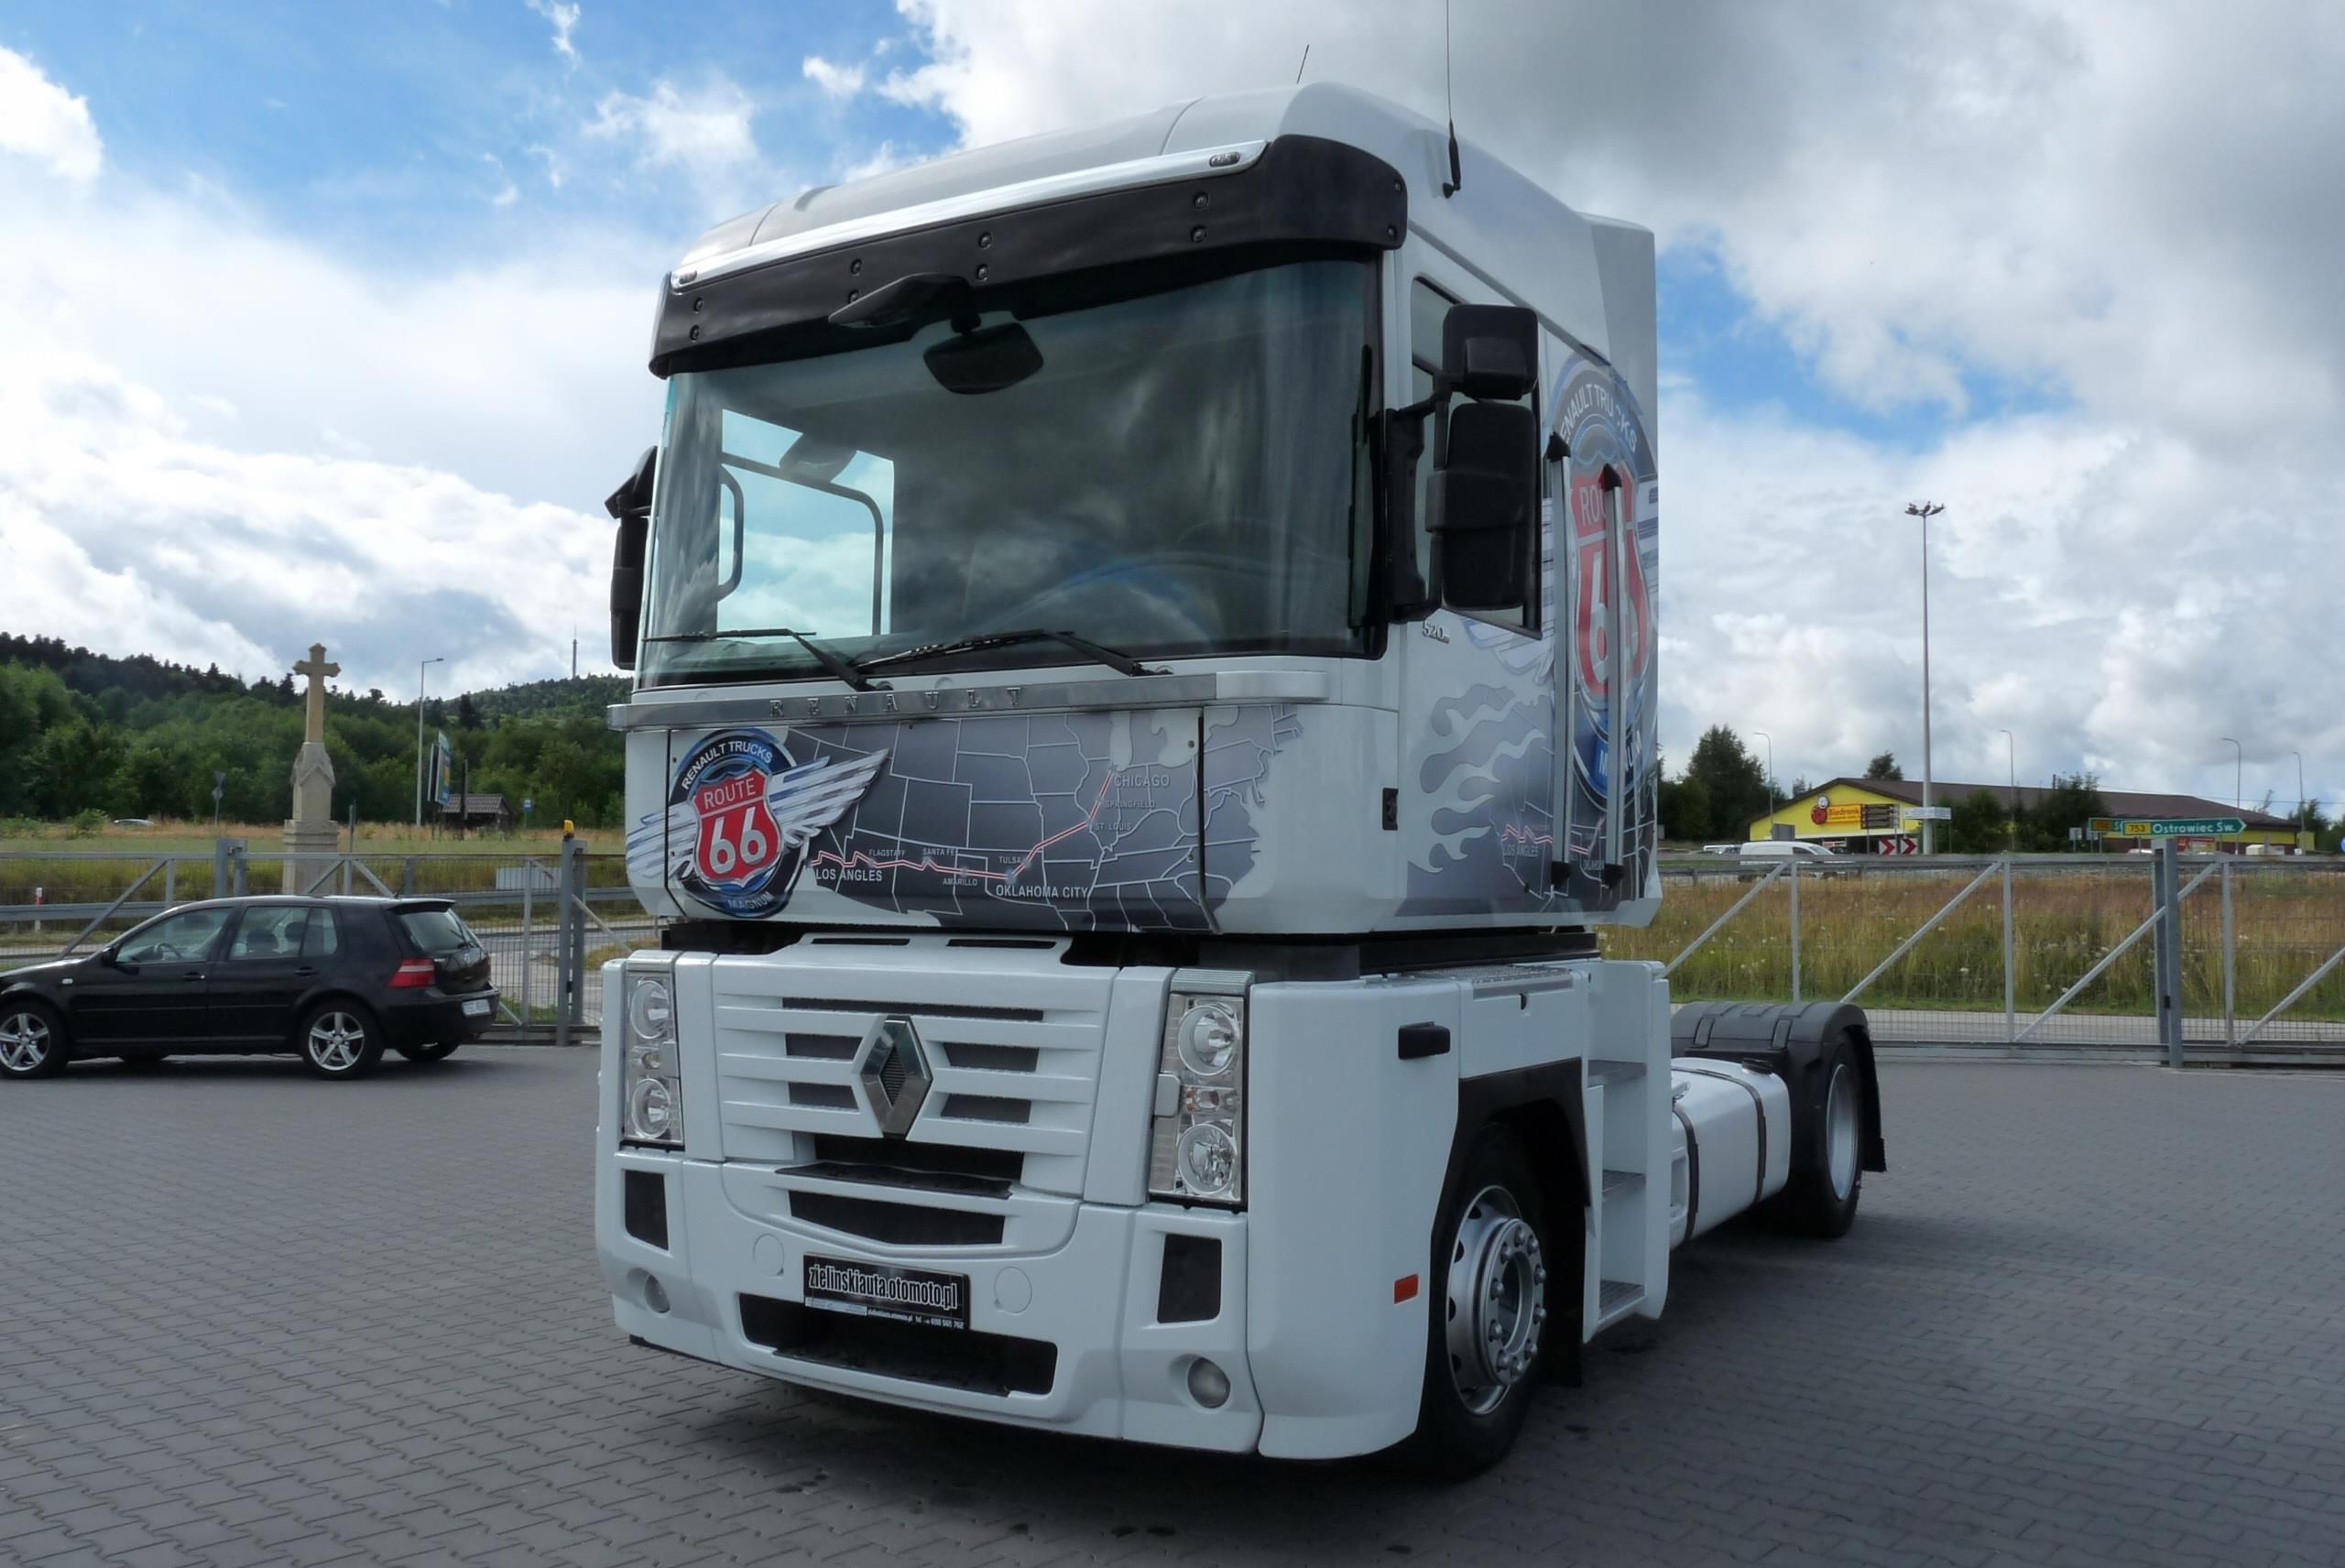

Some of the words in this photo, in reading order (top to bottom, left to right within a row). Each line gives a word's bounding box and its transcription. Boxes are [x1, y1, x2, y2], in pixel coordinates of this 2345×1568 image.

[1560, 384, 1592, 444] ENAULT
[769, 687, 1022, 717] RENAULT
[681, 744, 726, 789] RENAULT
[728, 740, 773, 764] TRUCKS
[1114, 774, 1170, 788] CHICAGO
[704, 778, 756, 810] ROUTE
[1106, 799, 1155, 808] SPRINGFIELD
[1109, 822, 1131, 831] LOUIS
[2153, 822, 2213, 833] Ostrowiec
[709, 806, 768, 875] 66
[868, 849, 905, 857] FLAGSTAFF
[922, 848, 944, 856] SANTA
[946, 848, 955, 856] FE
[816, 869, 836, 880] LOS
[839, 869, 883, 882] ANGLES
[943, 878, 977, 887] AMARILLO
[996, 885, 1059, 898] OKLAHOMA
[1063, 886, 1088, 898] CITY
[727, 890, 774, 909] MAGNUM
[808, 1263, 958, 1311] zielinskiauta.otomoto.pl
